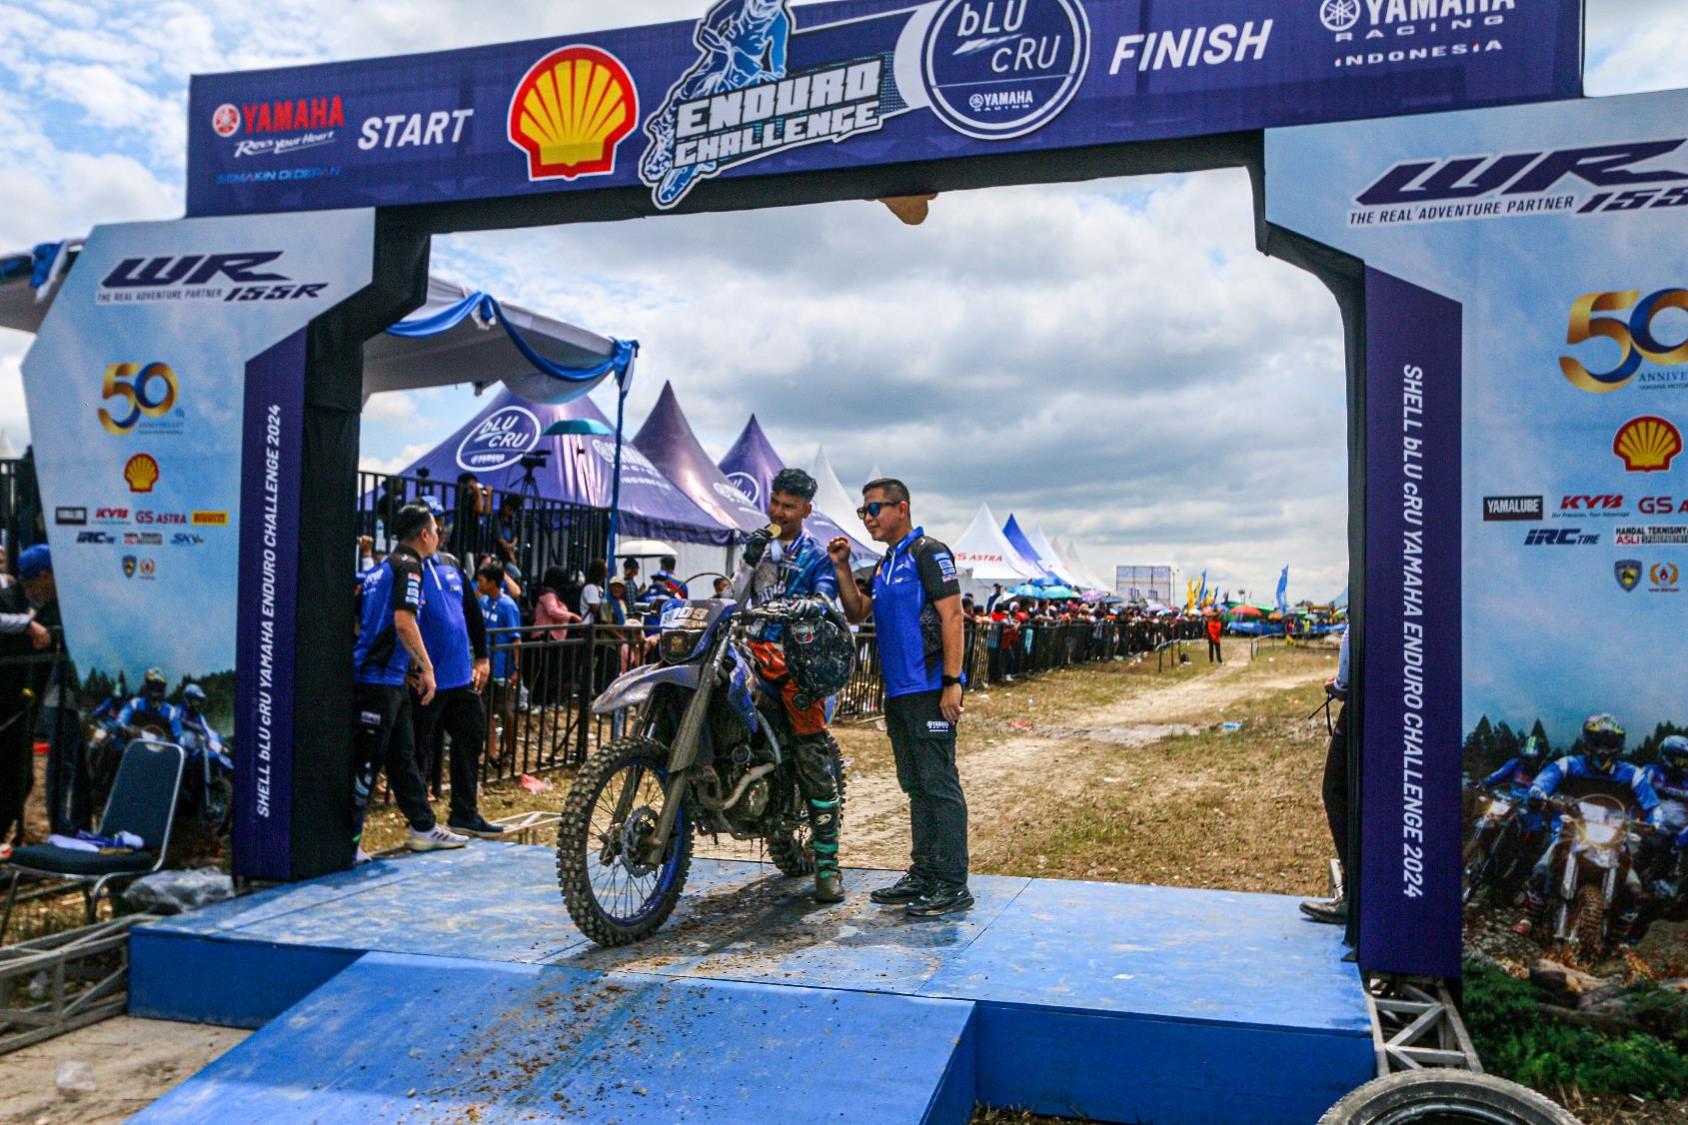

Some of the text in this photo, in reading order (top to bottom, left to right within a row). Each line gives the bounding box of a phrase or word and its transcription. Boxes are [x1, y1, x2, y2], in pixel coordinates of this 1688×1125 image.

[1335, 15, 1504, 42] RACING
[1366, 0, 1515, 25] YAMA
[1109, 19, 1273, 75] FINISH
[1335, 40, 1502, 67] INDONESIA
[242, 96, 344, 134] YAMAHA
[676, 60, 881, 139] ENDURO
[984, 90, 1033, 106] YAMAHA
[302, 131, 335, 144] Heart
[358, 109, 473, 150] START
[674, 101, 880, 167] CHALLENGE
[1350, 195, 1574, 225] THE REAL ADVENTURE PARTNER
[114, 292, 132, 301] REAL
[136, 289, 181, 300] ADVENTURE
[185, 288, 223, 298] PARTNER
[223, 282, 329, 302] 155R
[97, 361, 179, 436] 50
[1403, 364, 1423, 432] SHELL
[267, 404, 281, 446] 2024
[1403, 437, 1423, 480] bLU
[264, 447, 279, 548] CHALLENGE
[1487, 499, 1539, 513] YAMALUBE
[1560, 495, 1623, 510] KYB
[1638, 496, 1674, 514] GS
[136, 511, 187, 525] GS ASTRA
[1524, 528, 1601, 545] IRC TIRE
[1616, 526, 1688, 535] HANDAL TEKNISINY
[1616, 535, 1640, 544] ASLI
[262, 550, 276, 618] ENDURO
[1403, 531, 1423, 616] YAMAHA
[259, 620, 274, 688] YAMAHA
[1403, 622, 1423, 709] ENDURO
[259, 729, 272, 761] bLU
[257, 765, 270, 818] SHELL
[1403, 712, 1423, 842] CHALLENGE
[1403, 843, 1423, 898] 2024
